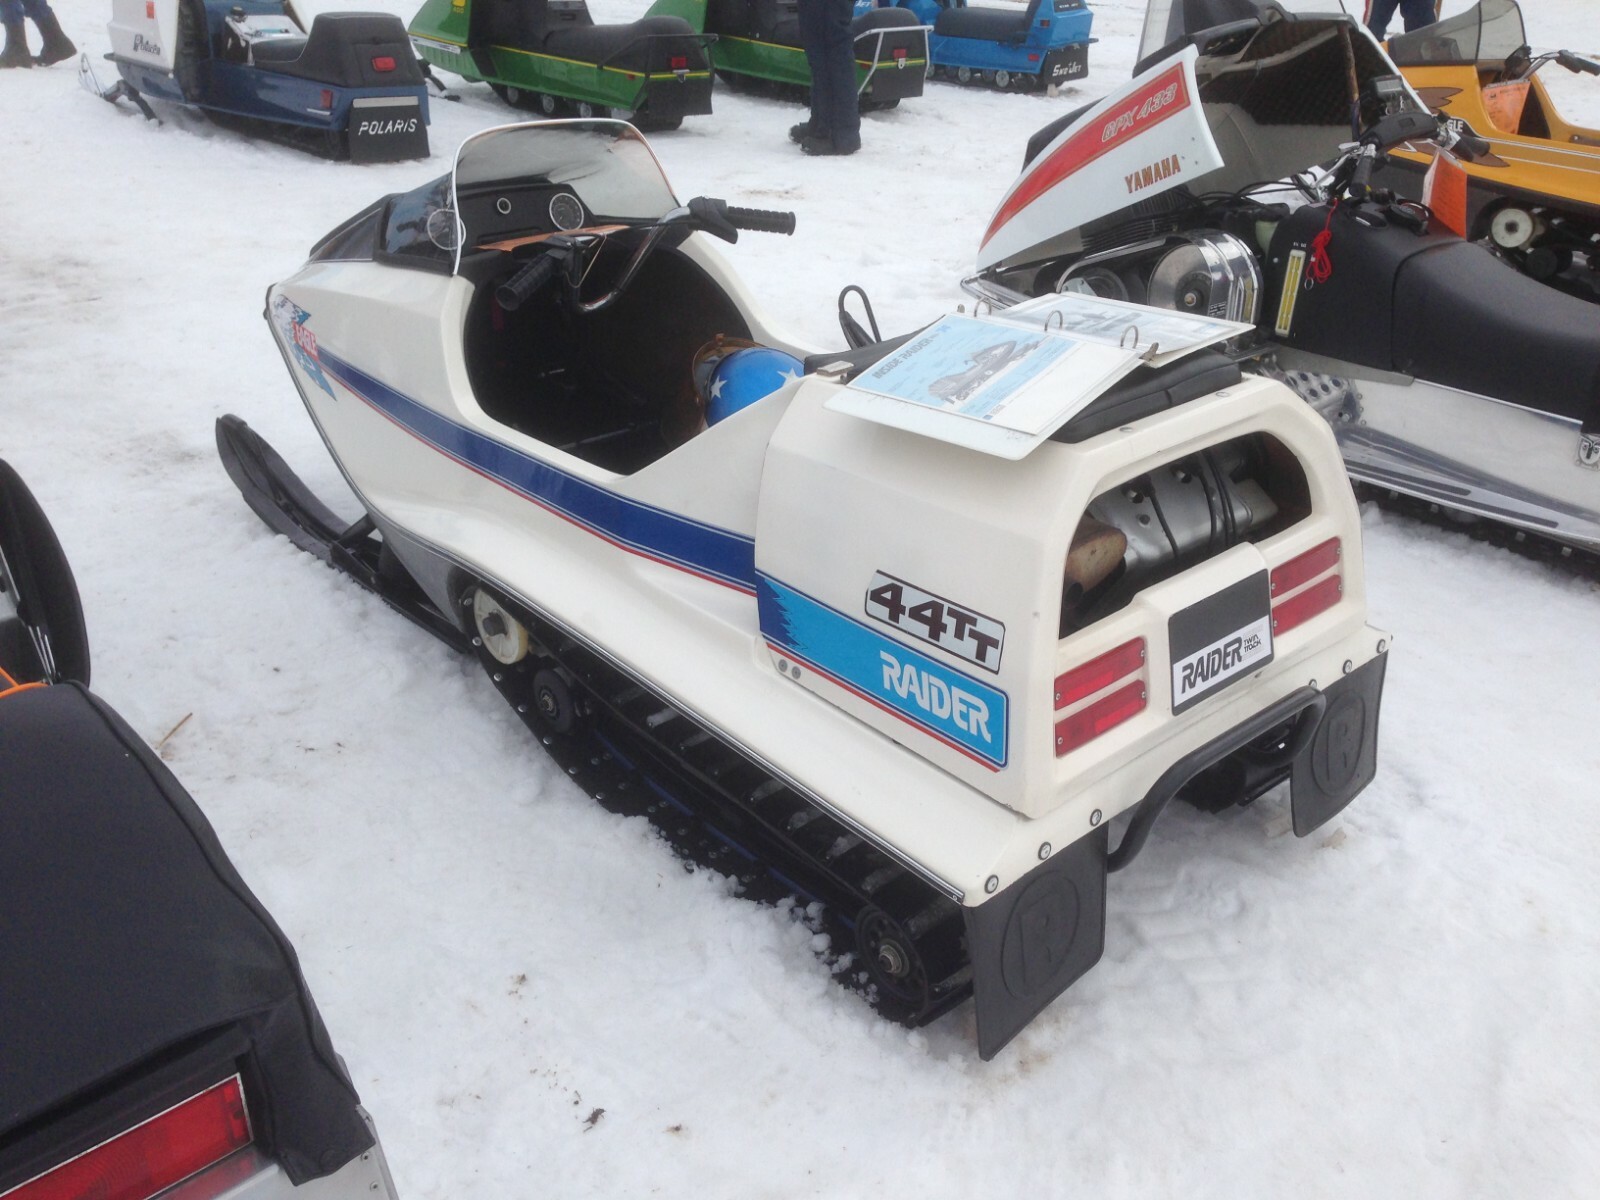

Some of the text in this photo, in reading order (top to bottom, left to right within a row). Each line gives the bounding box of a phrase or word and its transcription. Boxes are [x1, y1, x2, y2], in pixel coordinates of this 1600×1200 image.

[358, 118, 417, 136] POLARIS
[1102, 82, 1178, 142] GPX 433
[1125, 154, 1181, 194] YAMAHA
[1181, 636, 1243, 694] RAIDER
[879, 650, 992, 744] RAIDER
